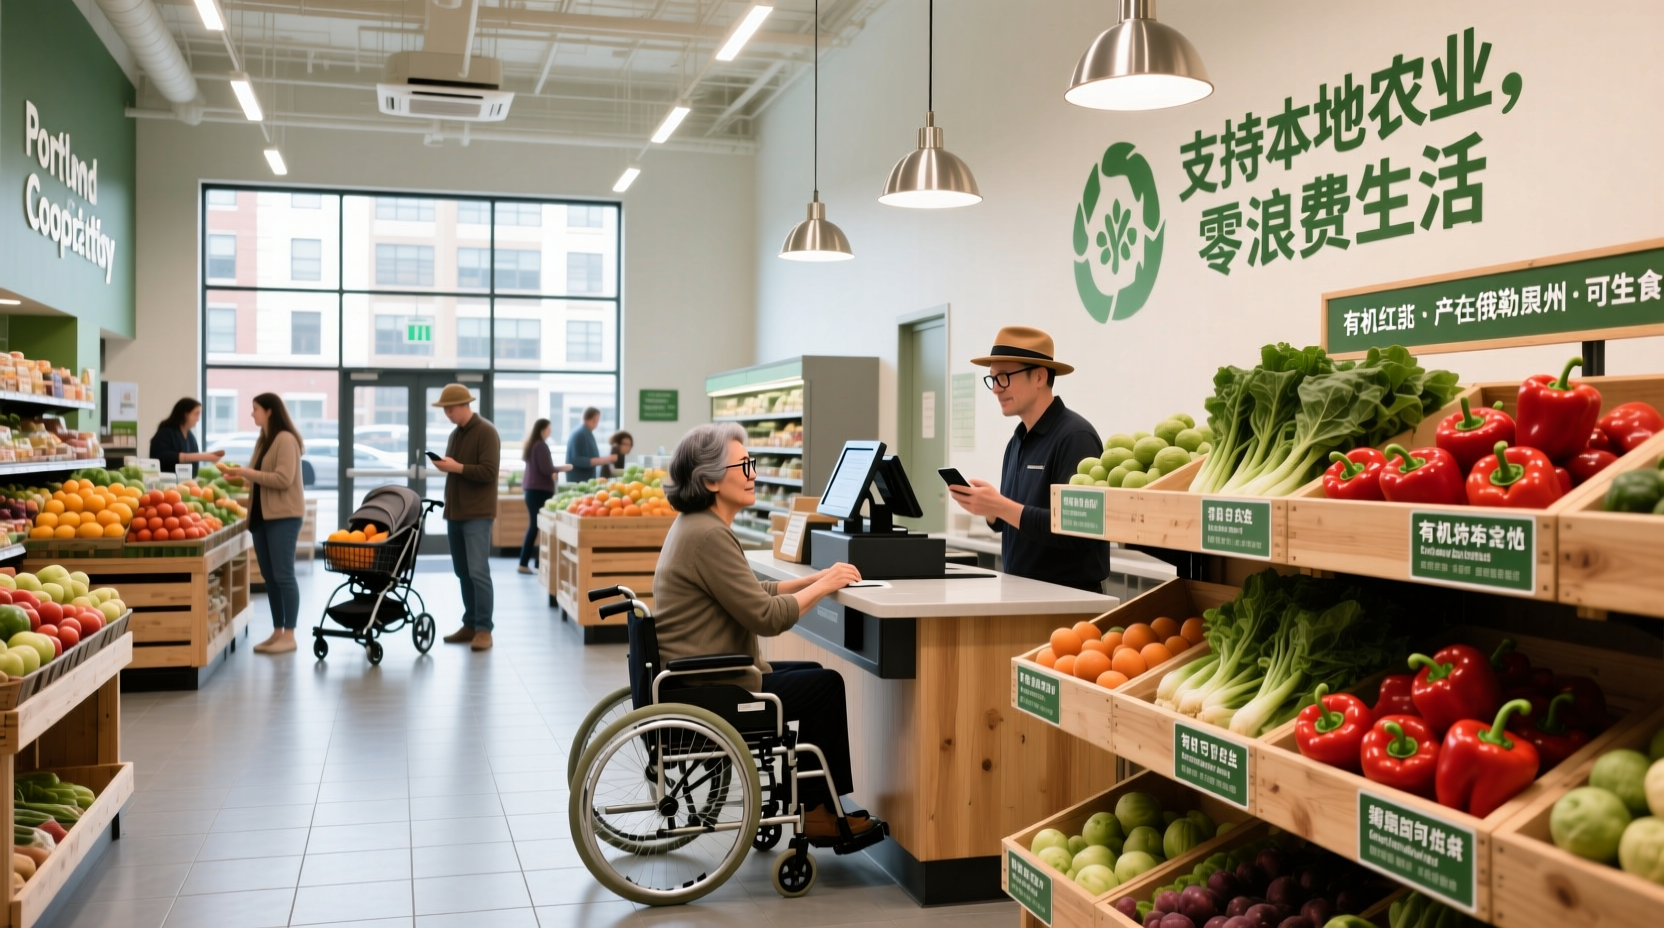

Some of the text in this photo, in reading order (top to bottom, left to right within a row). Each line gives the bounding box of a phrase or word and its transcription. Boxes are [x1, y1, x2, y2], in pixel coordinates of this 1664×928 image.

[1198, 131, 1487, 276] 零浪费生活
